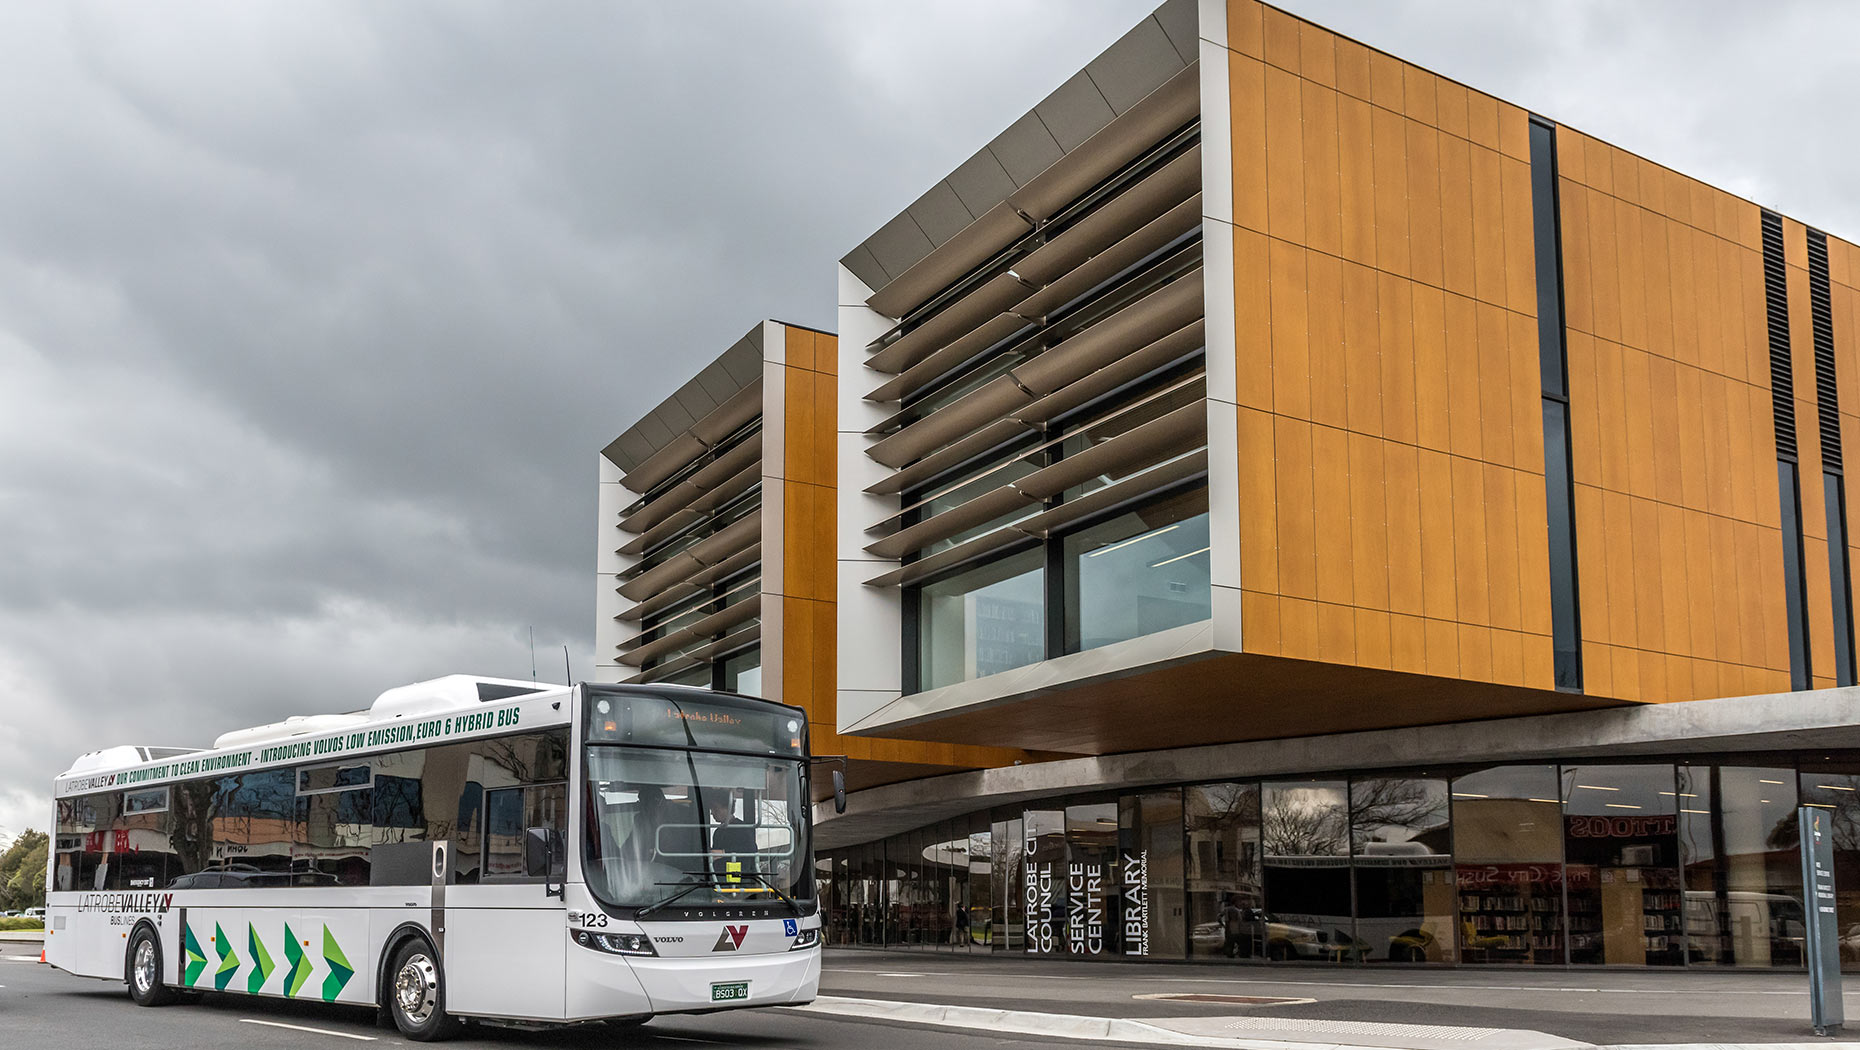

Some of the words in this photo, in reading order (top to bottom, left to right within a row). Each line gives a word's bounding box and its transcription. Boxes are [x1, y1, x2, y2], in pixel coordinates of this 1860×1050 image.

[116, 772, 128, 785] OUR
[129, 765, 169, 783] COMMITMENT
[171, 763, 179, 777] TO
[180, 760, 199, 775] CLEAN
[201, 752, 252, 772] ENVIRONMENT
[260, 741, 311, 763] INTRODUCING
[313, 736, 343, 754] VOLVOS
[346, 732, 366, 749] LOW
[445, 718, 451, 735] 6
[454, 712, 493, 733] HYBRID
[497, 707, 520, 727] BUS
[1026, 808, 1037, 856] CITY
[1140, 849, 1148, 890] MEMORIAL
[579, 913, 608, 928] 123
[683, 910, 769, 918] VOLGREN
[1026, 862, 1039, 953] LATROBE
[1040, 862, 1053, 953] COUNCIL
[1069, 863, 1085, 954] SERVICE
[1087, 864, 1102, 955] CENTRE
[1124, 853, 1142, 956] LIBRARY
[1141, 891, 1149, 928] BARTLETT
[715, 989, 734, 999] BS03
